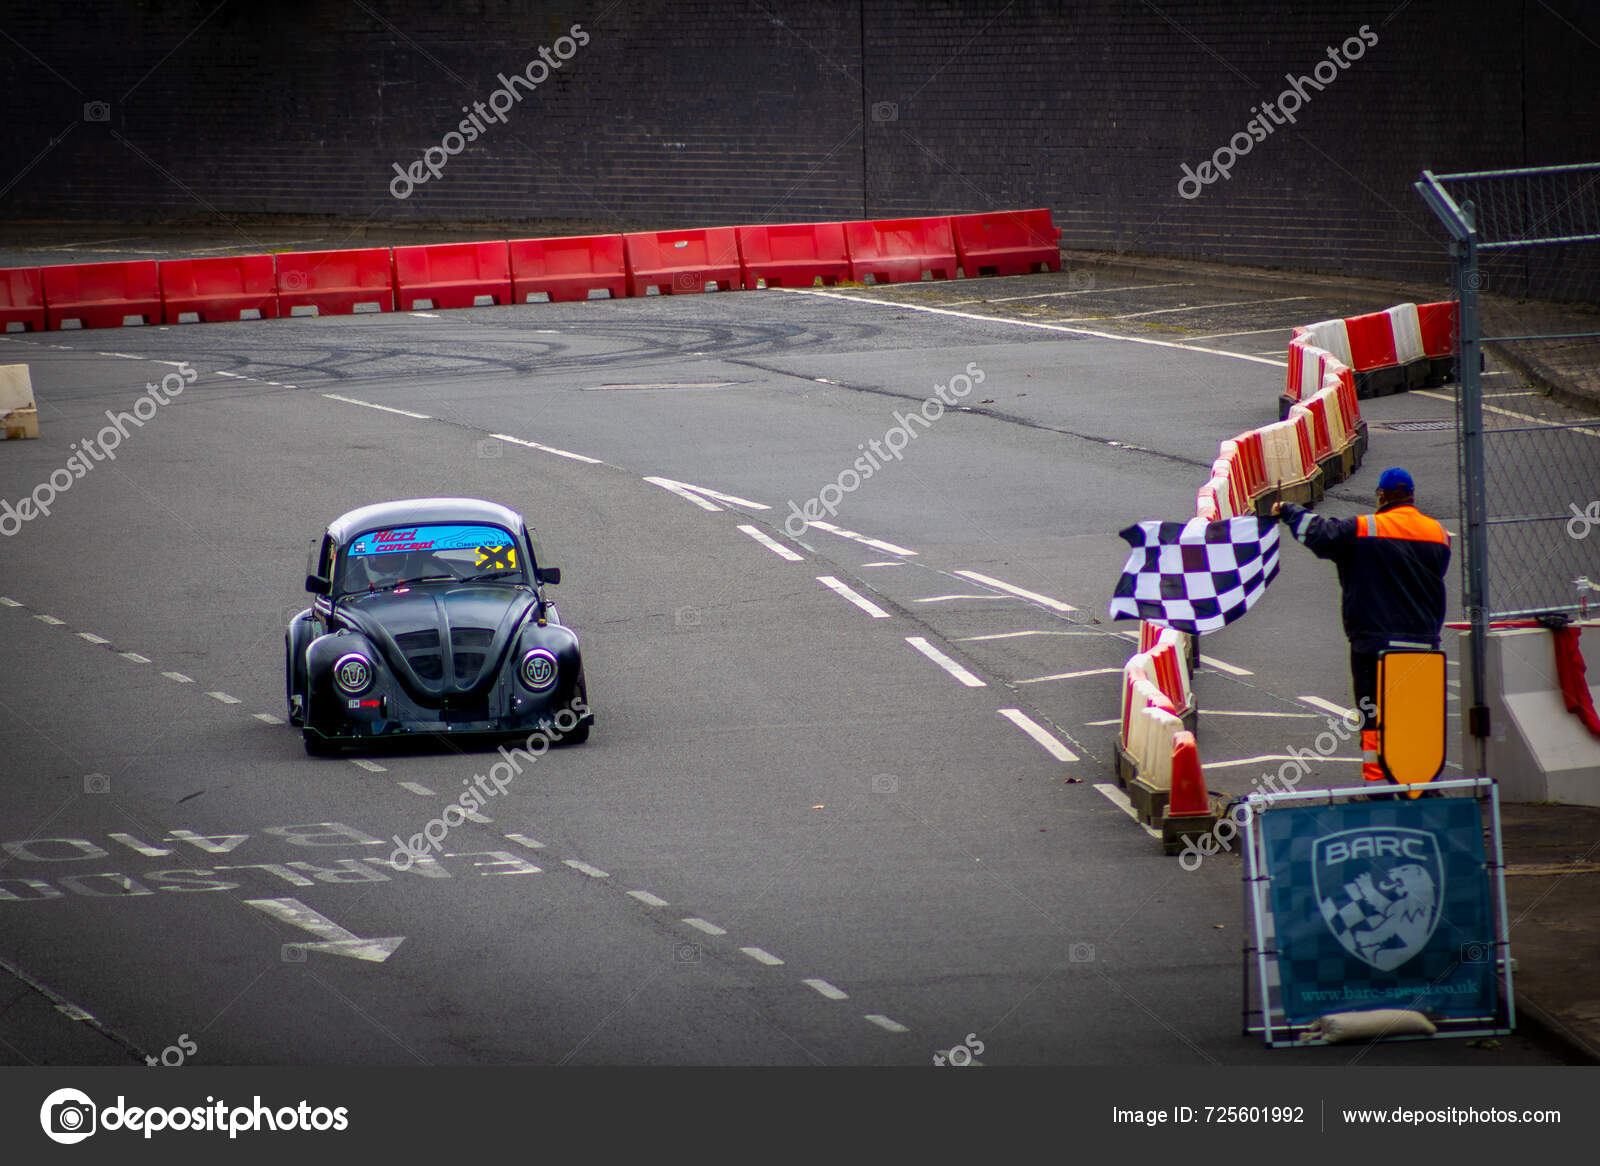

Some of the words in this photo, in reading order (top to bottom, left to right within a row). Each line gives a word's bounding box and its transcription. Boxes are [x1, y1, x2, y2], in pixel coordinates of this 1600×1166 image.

[1325, 836, 1428, 866] BARC
[0, 851, 543, 900] EARLSDO
[1301, 979, 1478, 1001] www.barc-speed.co.uk
